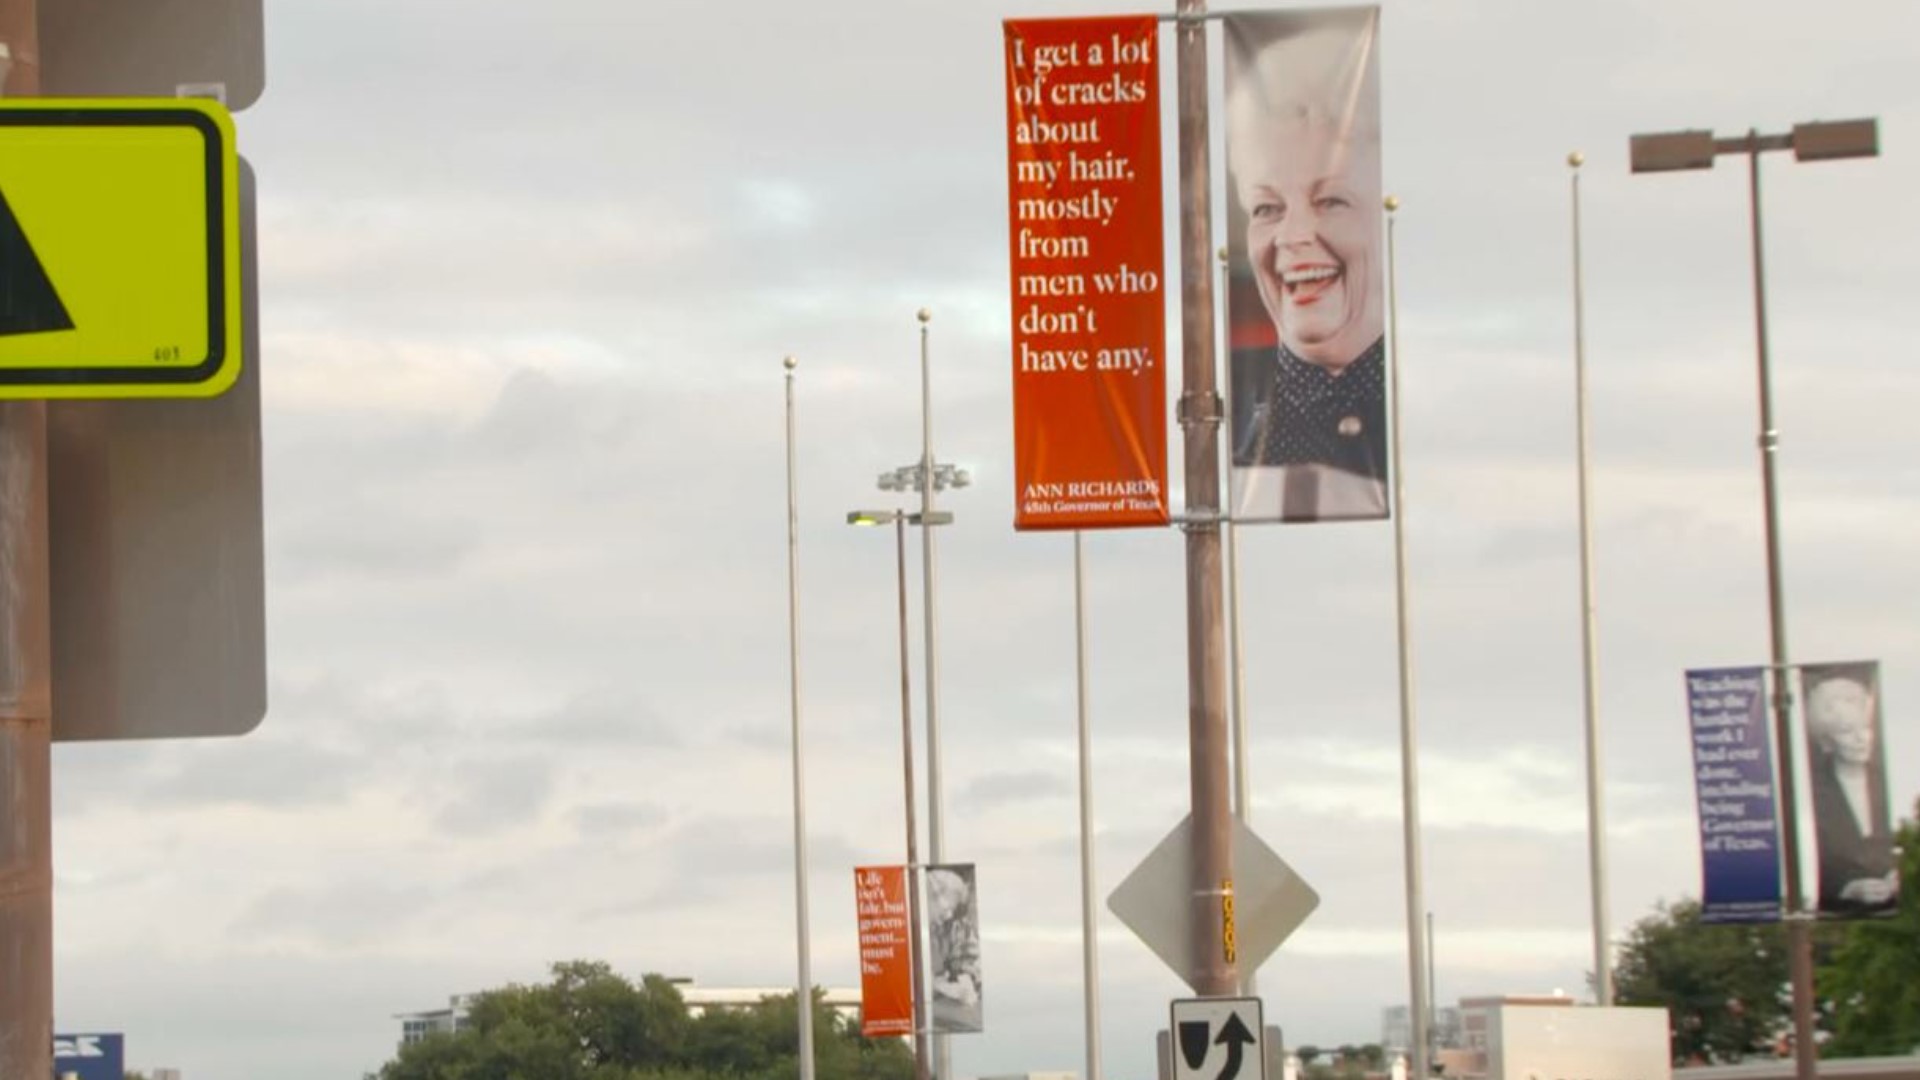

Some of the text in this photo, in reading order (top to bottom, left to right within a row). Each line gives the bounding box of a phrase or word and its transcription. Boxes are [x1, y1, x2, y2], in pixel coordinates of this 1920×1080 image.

[1013, 33, 1151, 73] I get a lot
[1014, 72, 1146, 105] of cracks
[1015, 115, 1100, 144] about
[1016, 159, 1062, 189] my
[1018, 189, 1118, 226] mostly
[1019, 227, 1089, 258] from
[1019, 263, 1159, 296] men who
[1020, 304, 1098, 334] don't
[1021, 342, 1154, 376] have any.
[1024, 480, 1160, 499] ANN RICHARDS
[1053, 500, 1111, 513] Governor
[1112, 498, 1125, 511] of
